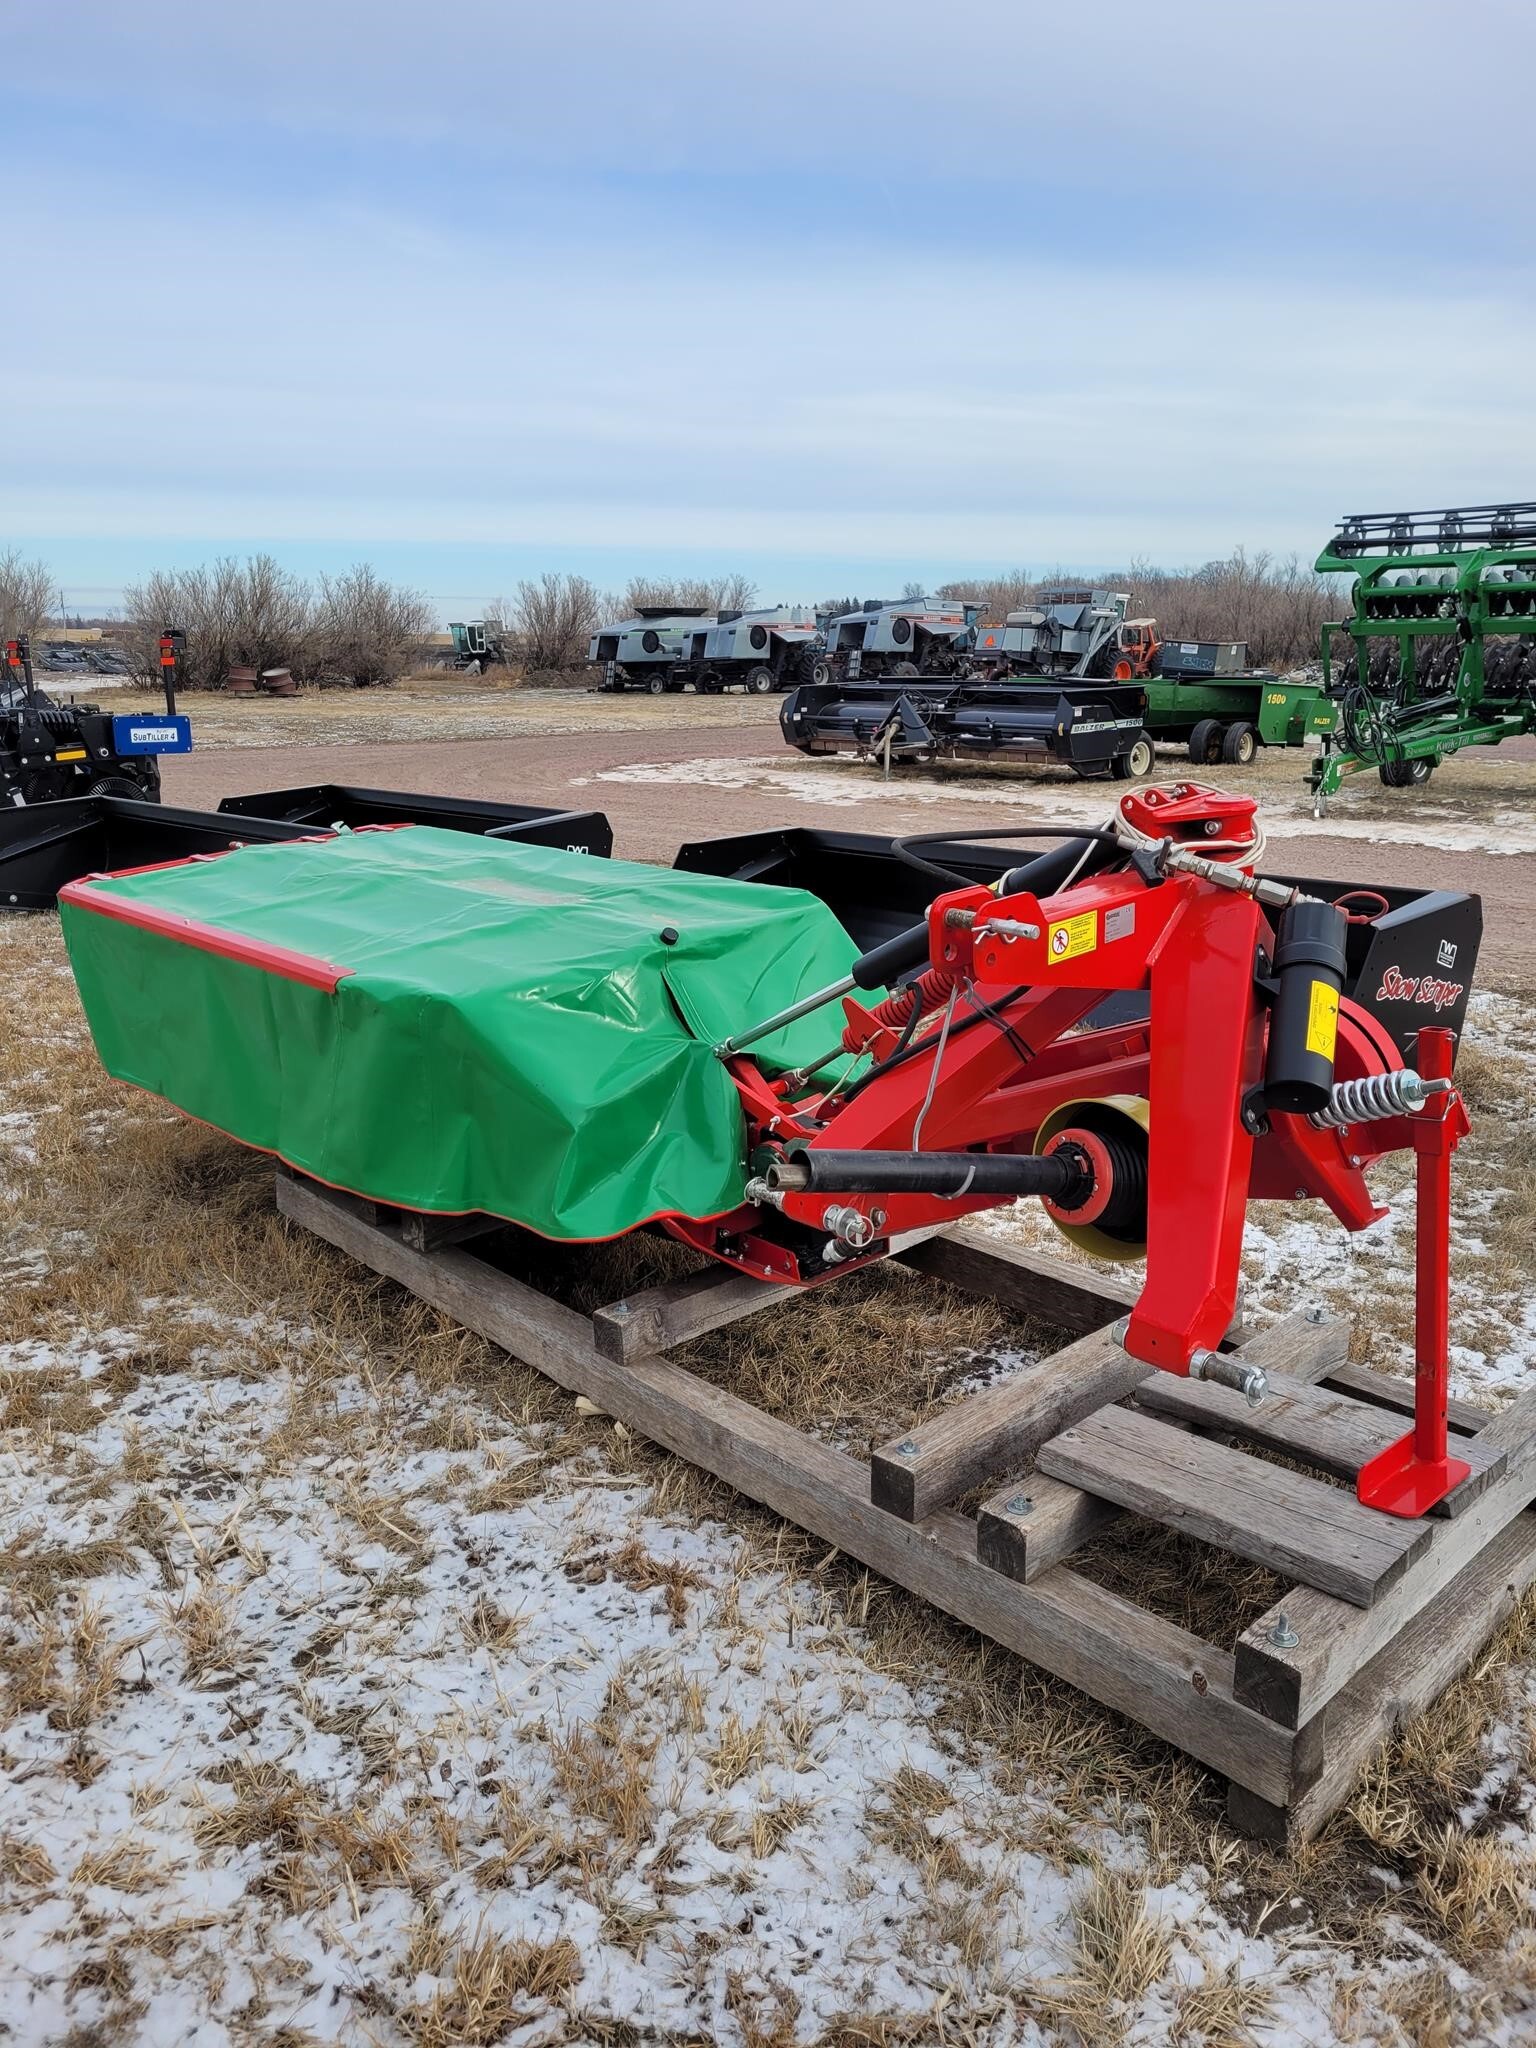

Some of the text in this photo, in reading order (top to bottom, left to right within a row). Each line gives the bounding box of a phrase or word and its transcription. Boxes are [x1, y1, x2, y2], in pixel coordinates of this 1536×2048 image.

[1266, 693, 1287, 704] 1500
[1073, 718, 1143, 733] BALZER 1500
[1376, 965, 1464, 1013] Snow Scraper
